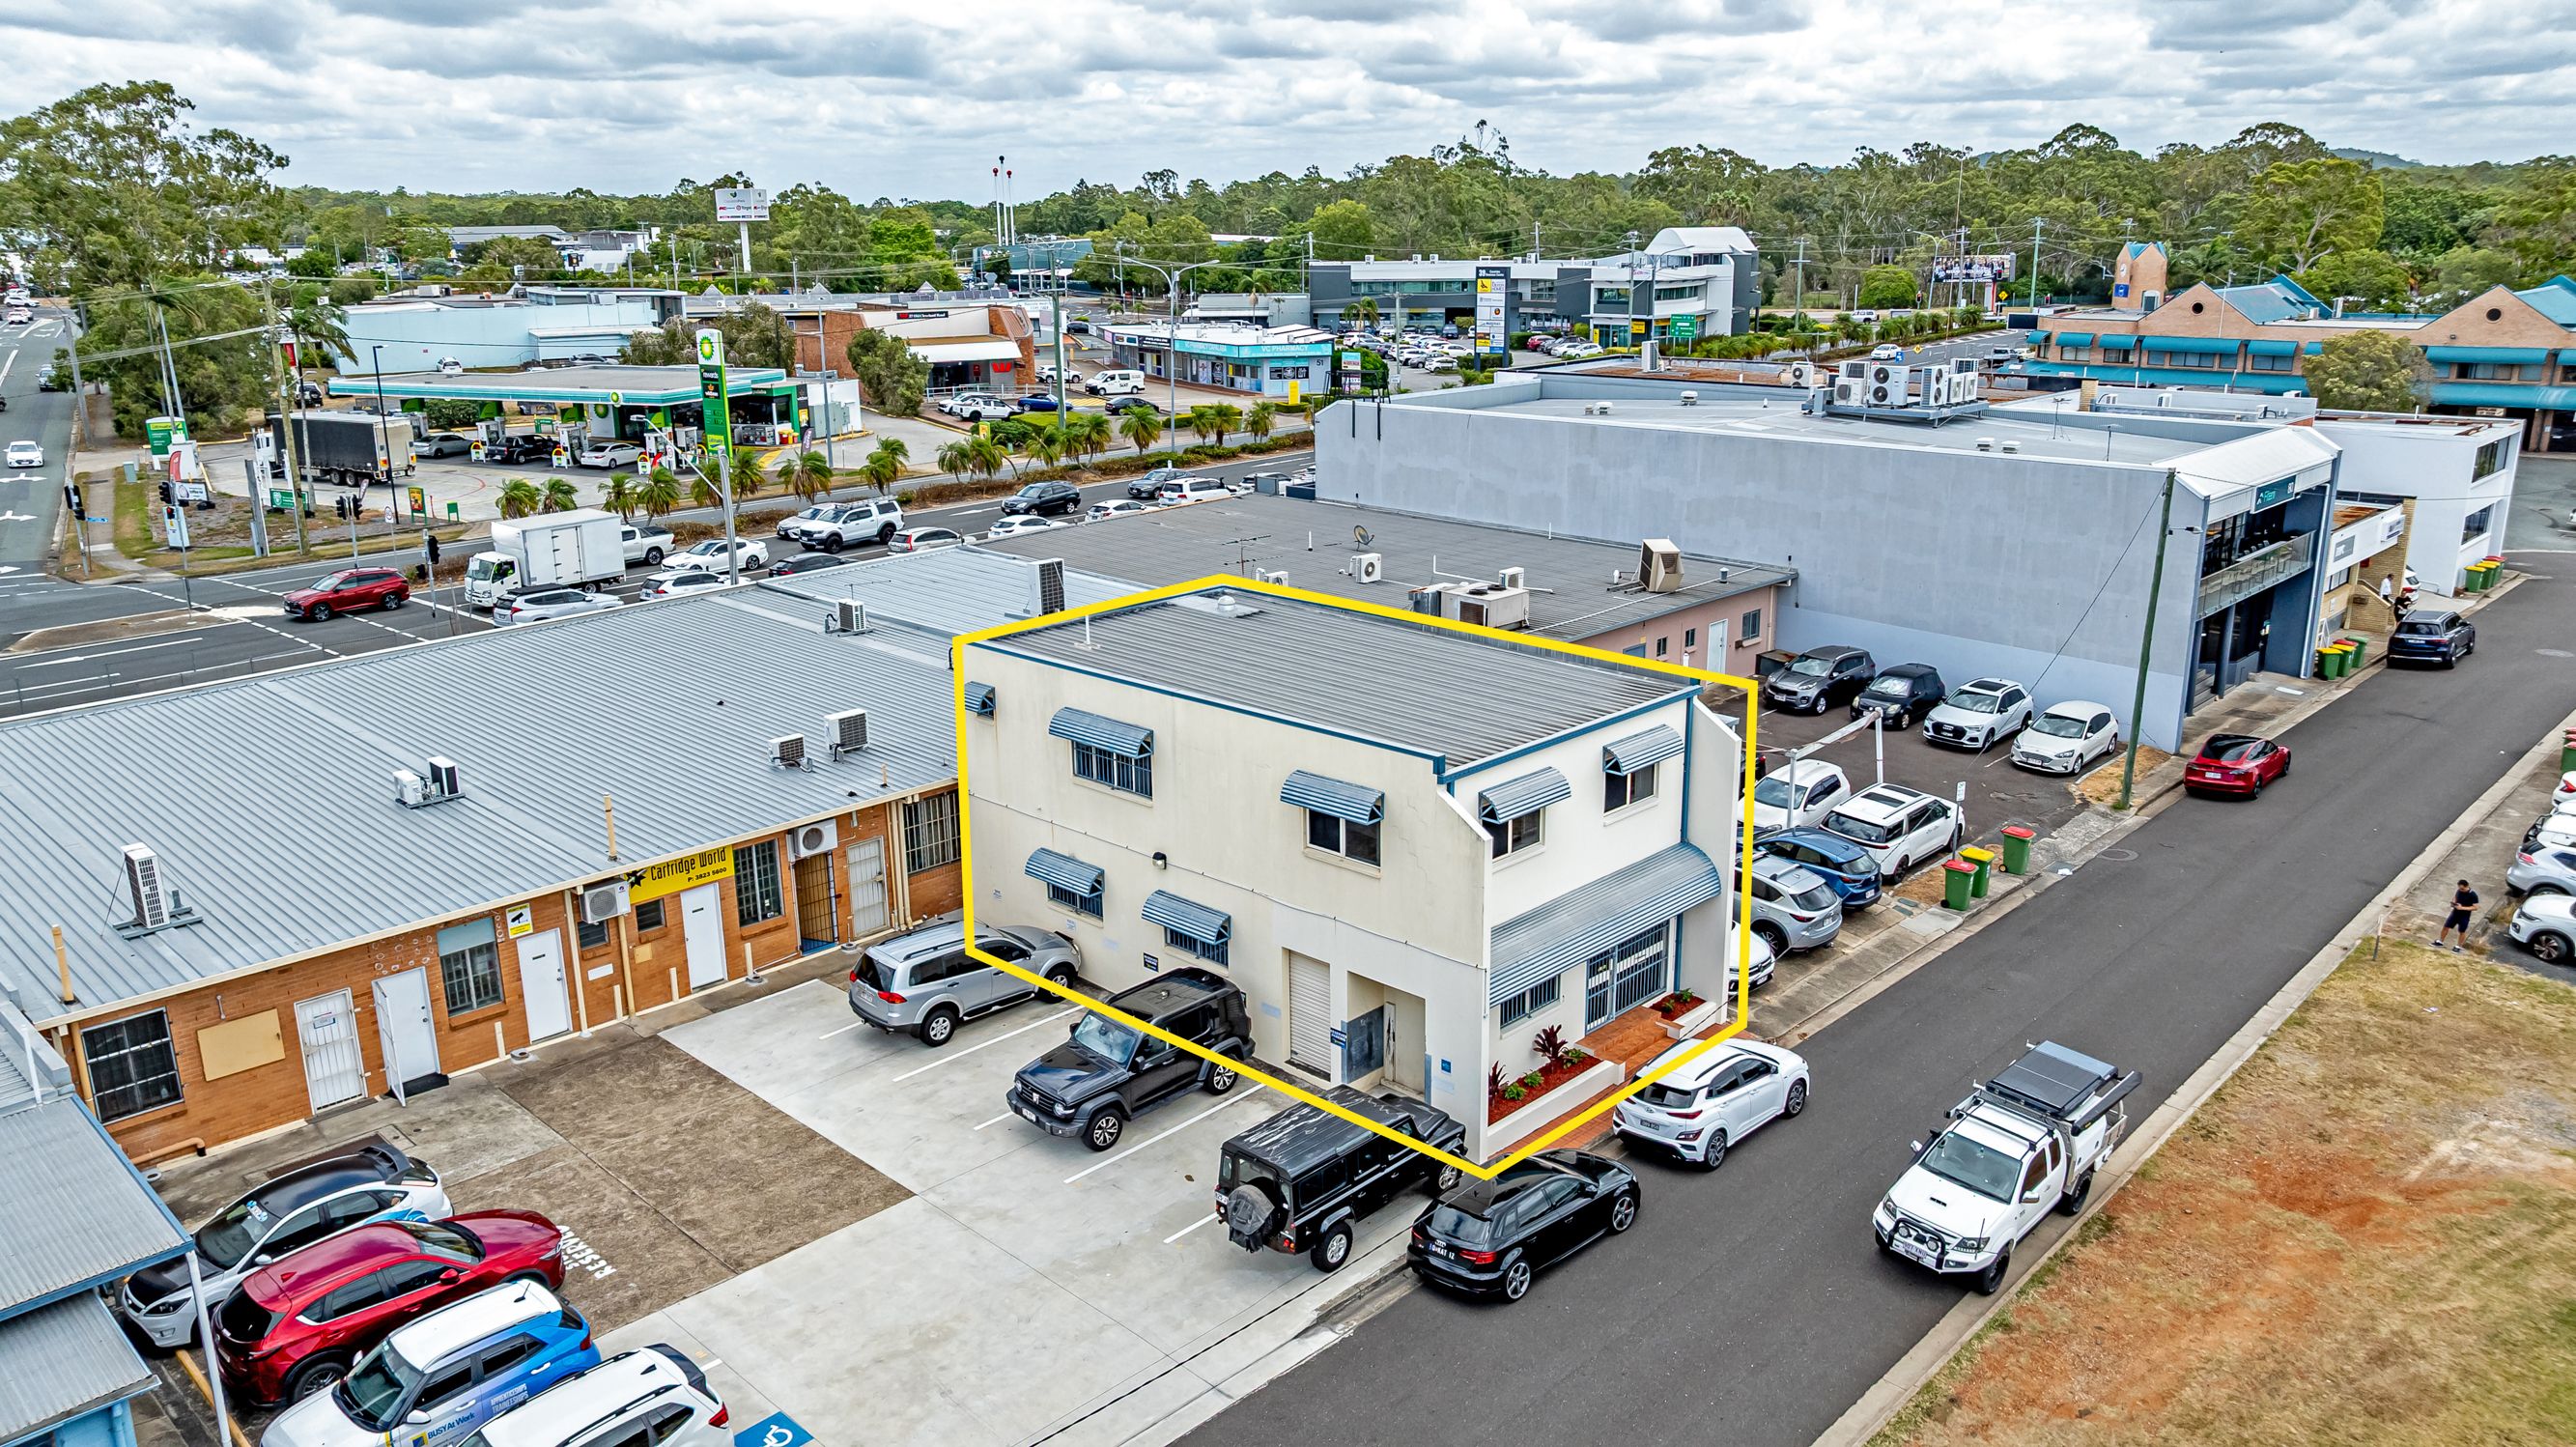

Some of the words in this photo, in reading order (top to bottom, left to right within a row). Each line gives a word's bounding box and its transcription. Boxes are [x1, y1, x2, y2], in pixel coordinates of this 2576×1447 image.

[651, 858, 695, 881] Cartridge
[699, 847, 726, 867] World
[695, 871, 711, 881] 3823
[427, 1424, 448, 1440] BUSY
[447, 1421, 456, 1431] At
[456, 1411, 475, 1427] Work
